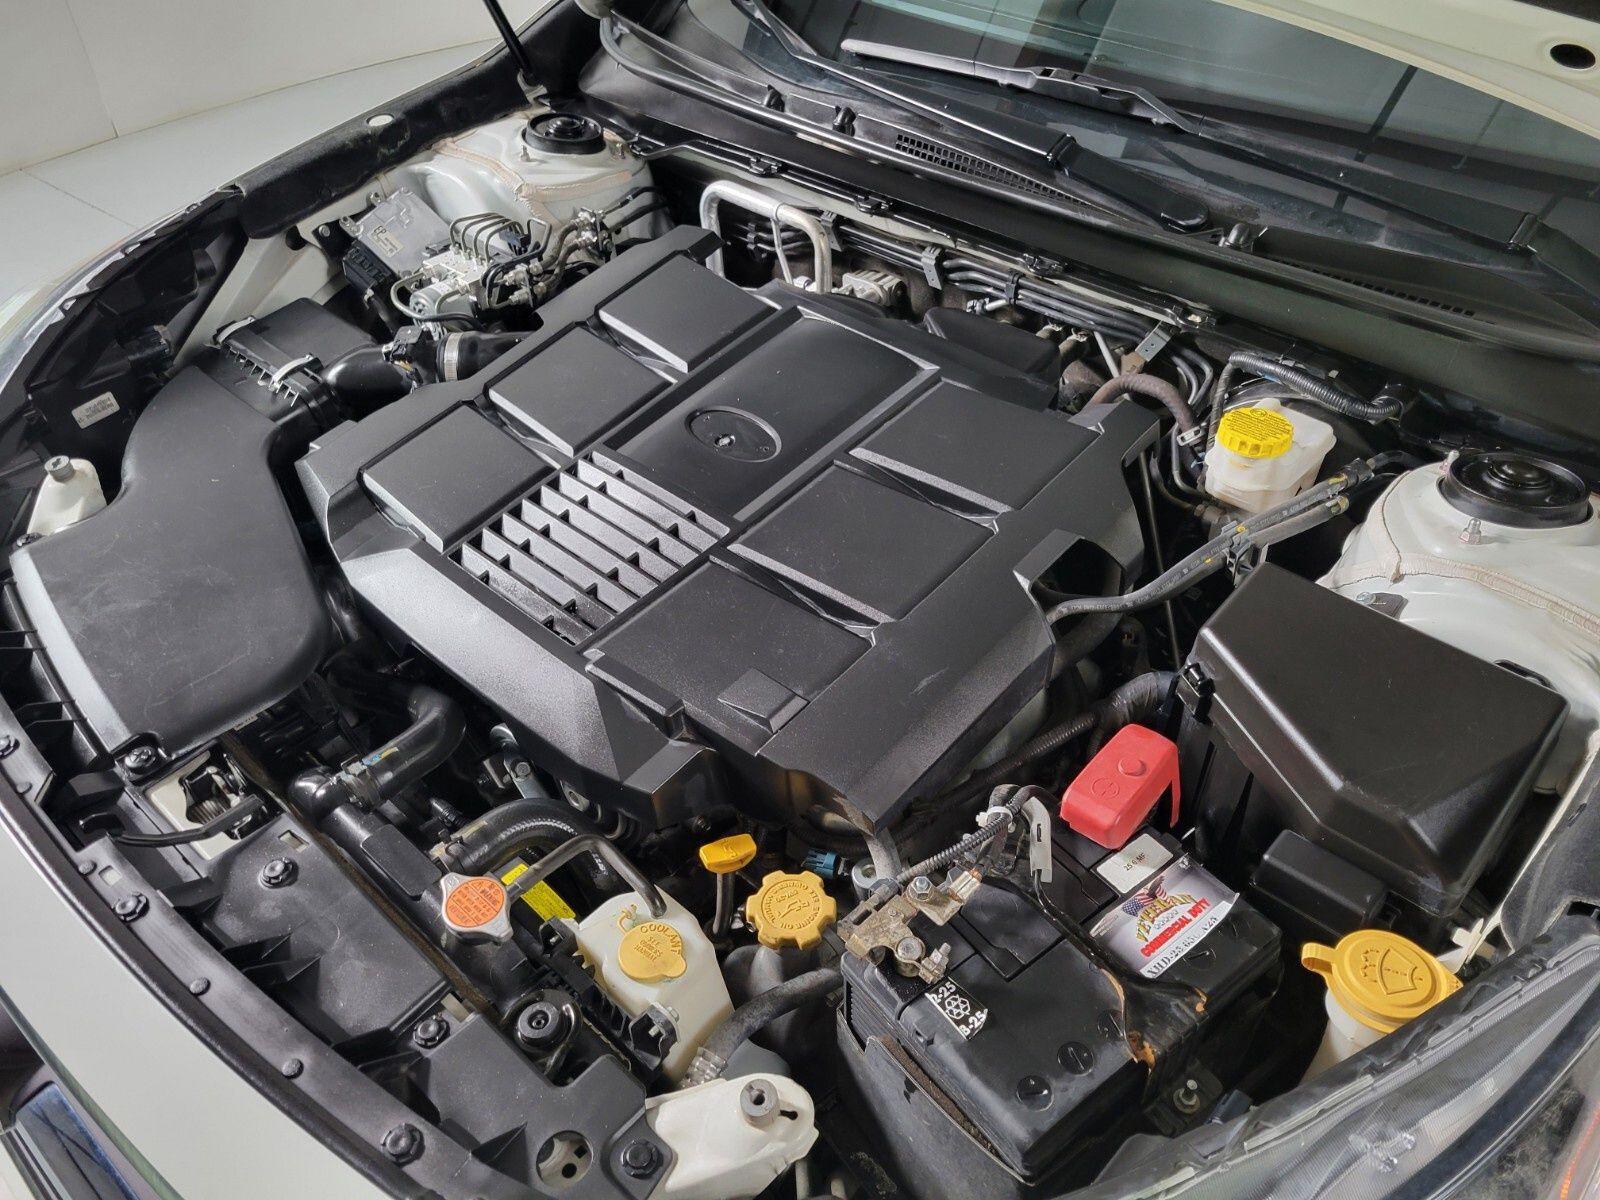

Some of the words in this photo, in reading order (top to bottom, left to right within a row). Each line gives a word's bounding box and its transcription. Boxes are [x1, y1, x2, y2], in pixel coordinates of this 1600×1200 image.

[640, 923, 682, 955] COOLANT
[1140, 914, 1192, 957] COMMERCIAL
[1187, 898, 1211, 920] DUTY
